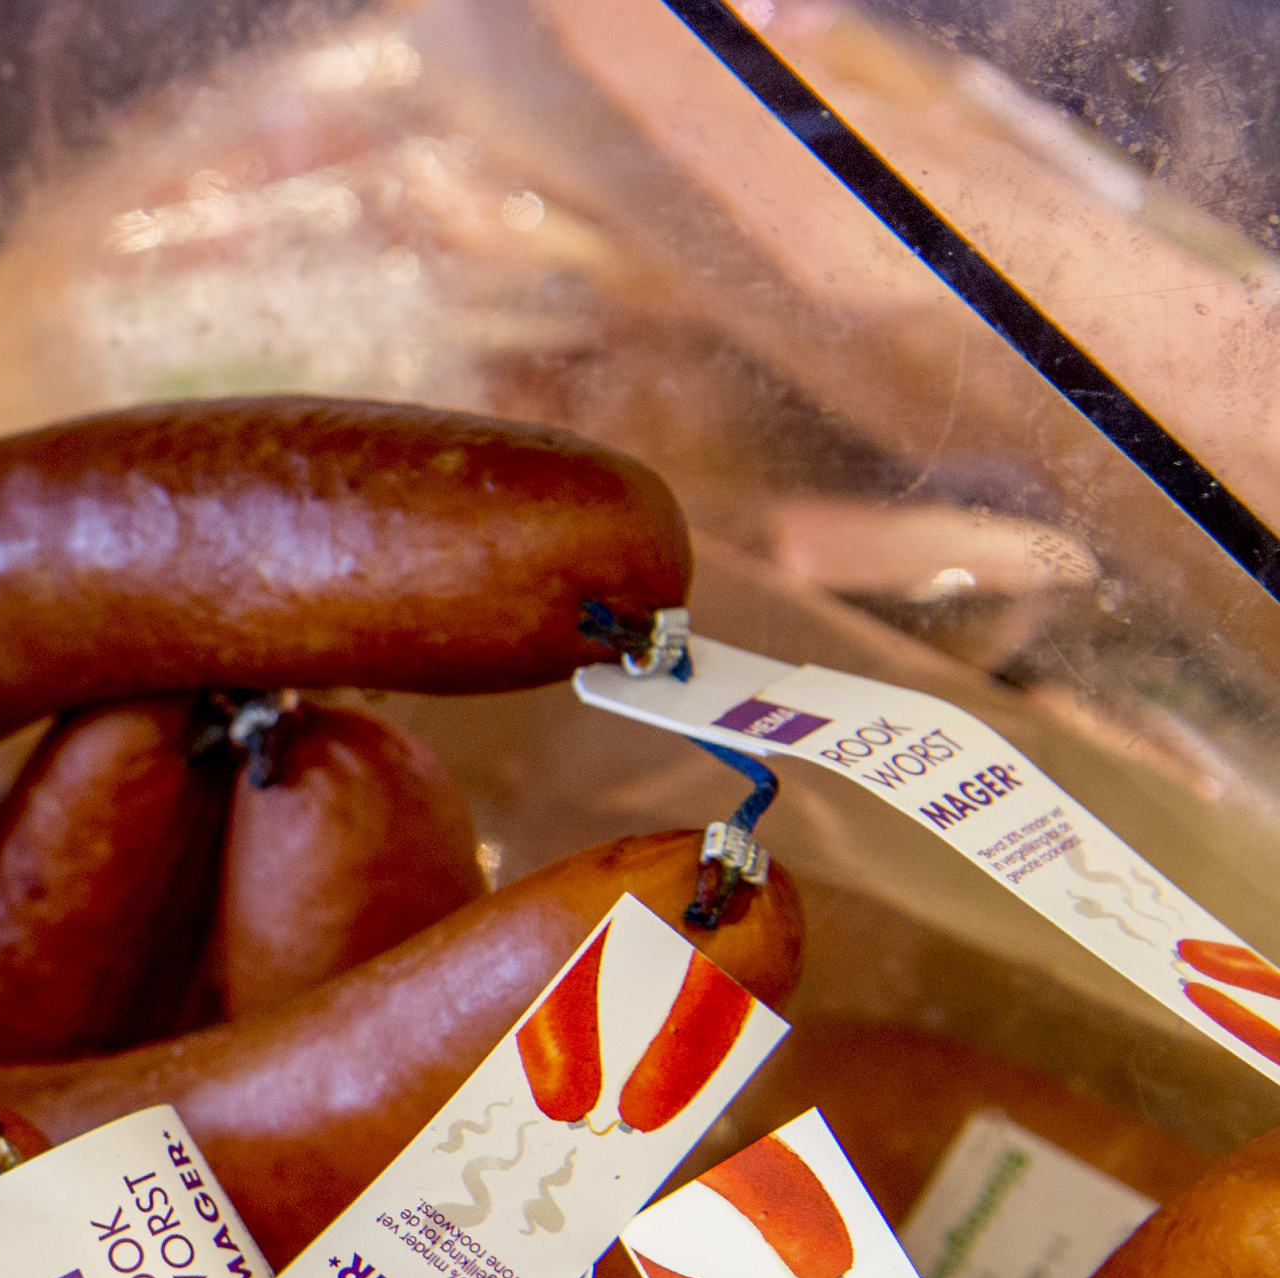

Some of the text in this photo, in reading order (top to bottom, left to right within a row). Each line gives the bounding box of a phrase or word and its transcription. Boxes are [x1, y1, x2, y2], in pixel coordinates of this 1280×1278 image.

[743, 707, 796, 738] HEMA
[820, 716, 913, 767] ROOK
[862, 729, 965, 790] WORST
[375, 1212, 400, 1234] vet
[400, 1208, 420, 1227] de
[418, 1224, 442, 1246] tot
[399, 1232, 449, 1272] minder
